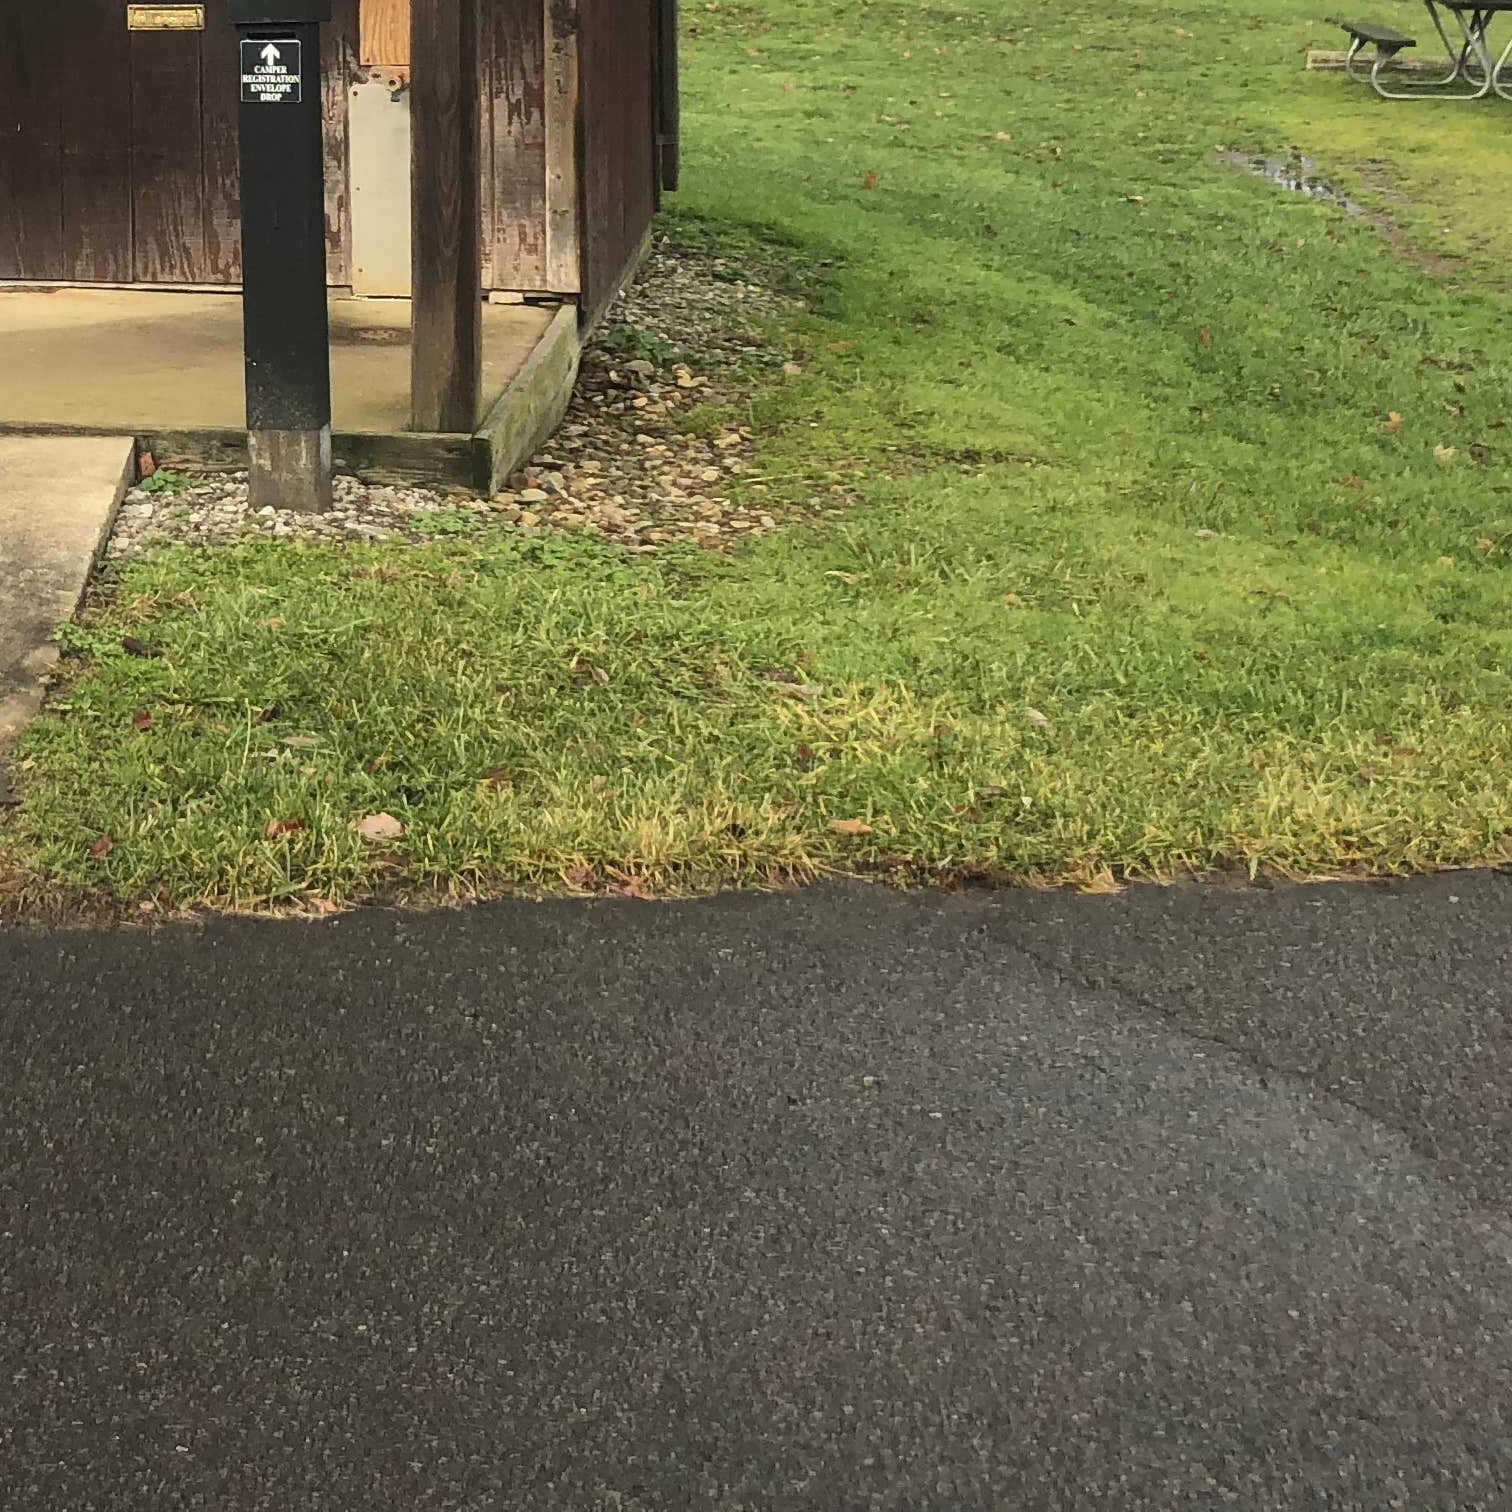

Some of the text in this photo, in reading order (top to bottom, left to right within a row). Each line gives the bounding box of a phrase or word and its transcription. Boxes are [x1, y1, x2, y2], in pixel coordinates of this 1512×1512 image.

[254, 65, 288, 74] CAMPER
[242, 74, 300, 83] REGISTRATION
[250, 83, 292, 93] ENVELOPE
[260, 93, 283, 101] DROP
